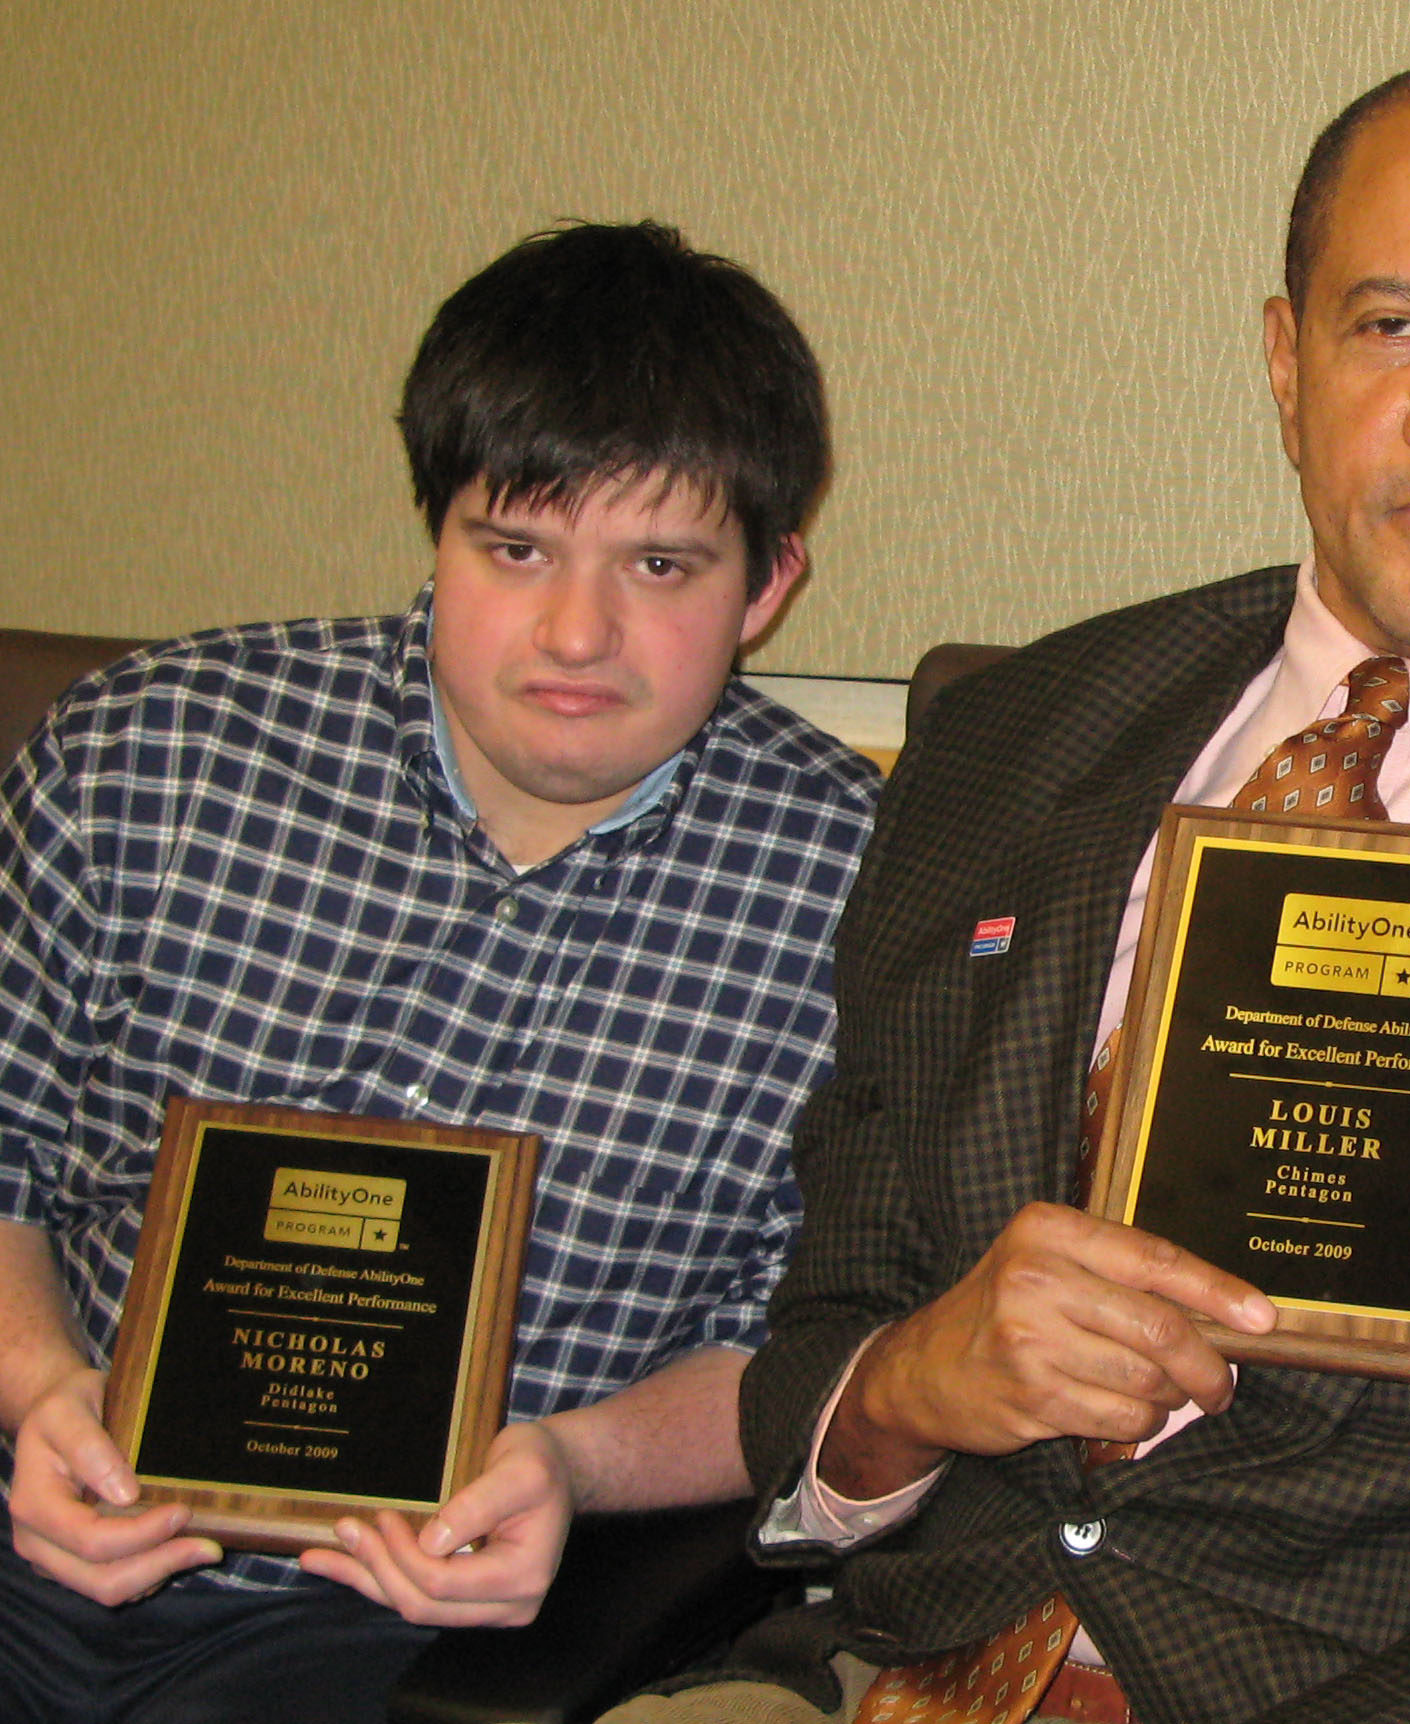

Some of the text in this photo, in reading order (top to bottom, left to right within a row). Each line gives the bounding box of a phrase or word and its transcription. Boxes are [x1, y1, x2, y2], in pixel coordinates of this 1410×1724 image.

[1284, 961, 1370, 979] PROGRAM
[1225, 1005, 1303, 1026] Department
[1306, 1014, 1323, 1028] of
[1323, 1015, 1378, 1033] Defense
[1201, 1035, 1254, 1055] Award
[1259, 1040, 1283, 1058] for
[1285, 1042, 1361, 1066] Excellent
[1269, 1099, 1372, 1129] LOUIS
[1250, 1126, 1382, 1160] MILLER
[1277, 1164, 1346, 1185] Chimes
[284, 1181, 394, 1206] AbilityOne
[1265, 1179, 1352, 1203] Pentagon
[276, 1221, 351, 1237] PROGRAM
[1249, 1236, 1352, 1260] October 2009
[224, 1255, 425, 1286] Department of Defense AbilityOne
[203, 1279, 438, 1314] Award for Excellent Performance
[232, 1327, 385, 1358] NICHOLAS
[240, 1351, 369, 1380] MORENO
[268, 1383, 335, 1400] Didlake
[260, 1395, 338, 1414] Pentagon
[246, 1440, 338, 1459] October 2009
